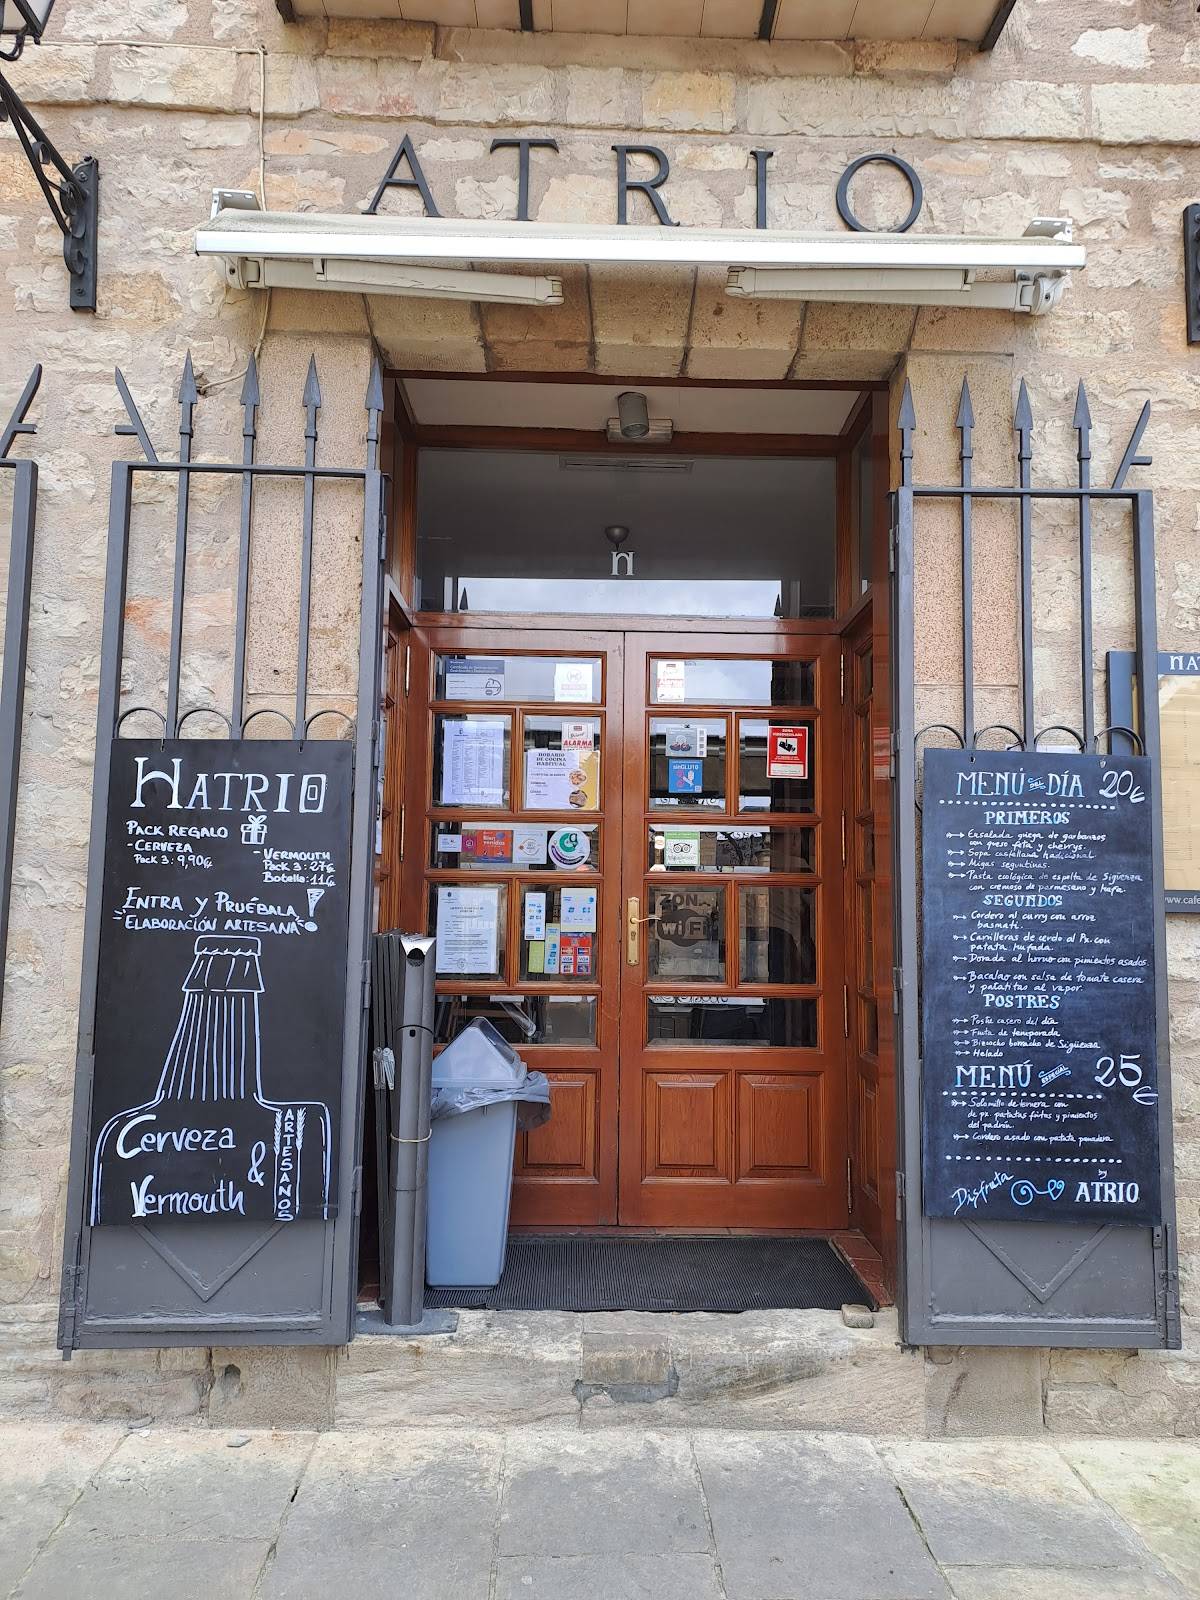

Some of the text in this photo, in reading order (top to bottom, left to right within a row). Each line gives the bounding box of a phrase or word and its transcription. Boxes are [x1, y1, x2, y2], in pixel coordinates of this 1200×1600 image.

[362, 133, 923, 233] ATRIO
[130, 757, 327, 813] HATRIO
[956, 768, 1025, 796] MENÚ
[1046, 770, 1085, 797] DÍA
[984, 810, 1071, 825] PRIMEROS
[168, 825, 229, 838] REGALO
[968, 828, 1013, 839] Ensalada
[1048, 831, 1059, 839] de
[1062, 831, 1106, 843] garbanzos
[987, 841, 1008, 850] queso
[1012, 840, 1033, 851] feta
[1036, 843, 1043, 852] y
[968, 848, 991, 859] Sopa
[968, 858, 995, 869] Migas
[966, 870, 993, 880] Pasta
[1052, 872, 1083, 882] espelta
[1086, 873, 1098, 881] de
[1089, 886, 1097, 896] y
[983, 894, 1063, 907] SEGUNDOS
[971, 910, 1004, 919] Cordero
[1008, 911, 1018, 919] al
[1022, 913, 1048, 923] curry
[1023, 932, 1035, 941] de
[1038, 932, 1063, 942] cerdo
[1066, 933, 1076, 942] al
[970, 942, 1007, 952] patata
[969, 953, 1006, 962] Dorada
[1011, 954, 1023, 962] al
[967, 970, 1011, 982] Bacalao
[1031, 971, 1057, 981] salsa
[1060, 971, 1072, 981] de
[1076, 971, 1110, 982] tomate
[968, 983, 975, 993] y
[1034, 983, 1046, 991] al
[983, 993, 1061, 1010] POSTRES
[997, 1018, 1022, 1026] casero
[1026, 1016, 1038, 1025] del
[1012, 1028, 1061, 1040] temporada
[1045, 1039, 1056, 1048] de
[973, 1049, 1004, 1057] Helado
[955, 1060, 1033, 1089] MENÚ
[116, 1114, 236, 1159] Cerveza
[278, 1108, 294, 1221] ARTESANOS
[130, 1175, 245, 1218] Vermouth
[951, 1171, 1014, 1215] Disfruta
[1074, 1181, 1140, 1203] ATRIO
